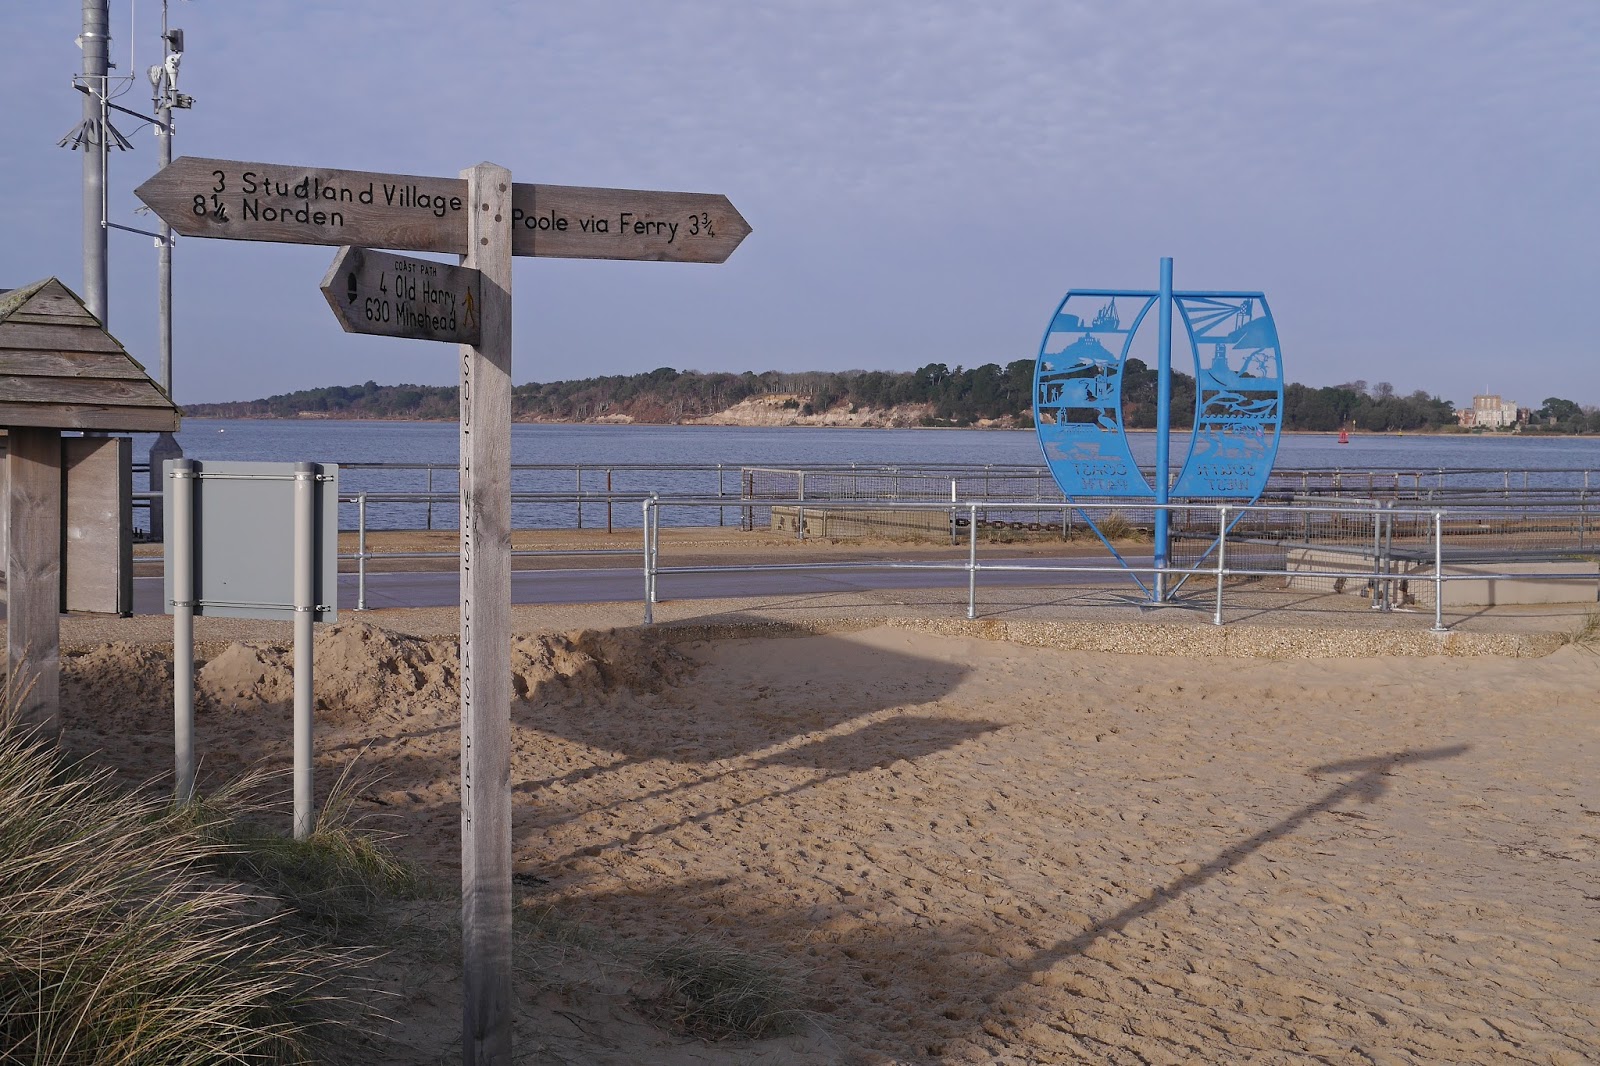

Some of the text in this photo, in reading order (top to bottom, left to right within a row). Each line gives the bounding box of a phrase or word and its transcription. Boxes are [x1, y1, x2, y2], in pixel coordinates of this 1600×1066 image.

[212, 170, 462, 217] 3 Studland Village
[242, 198, 344, 226] Norden
[511, 208, 569, 232] Poole
[579, 215, 609, 233] via
[620, 213, 679, 244] Ferry
[394, 260, 437, 277] COAST PATH
[379, 271, 456, 316] 4 Old Harry
[365, 297, 456, 333] 630 Minehead
